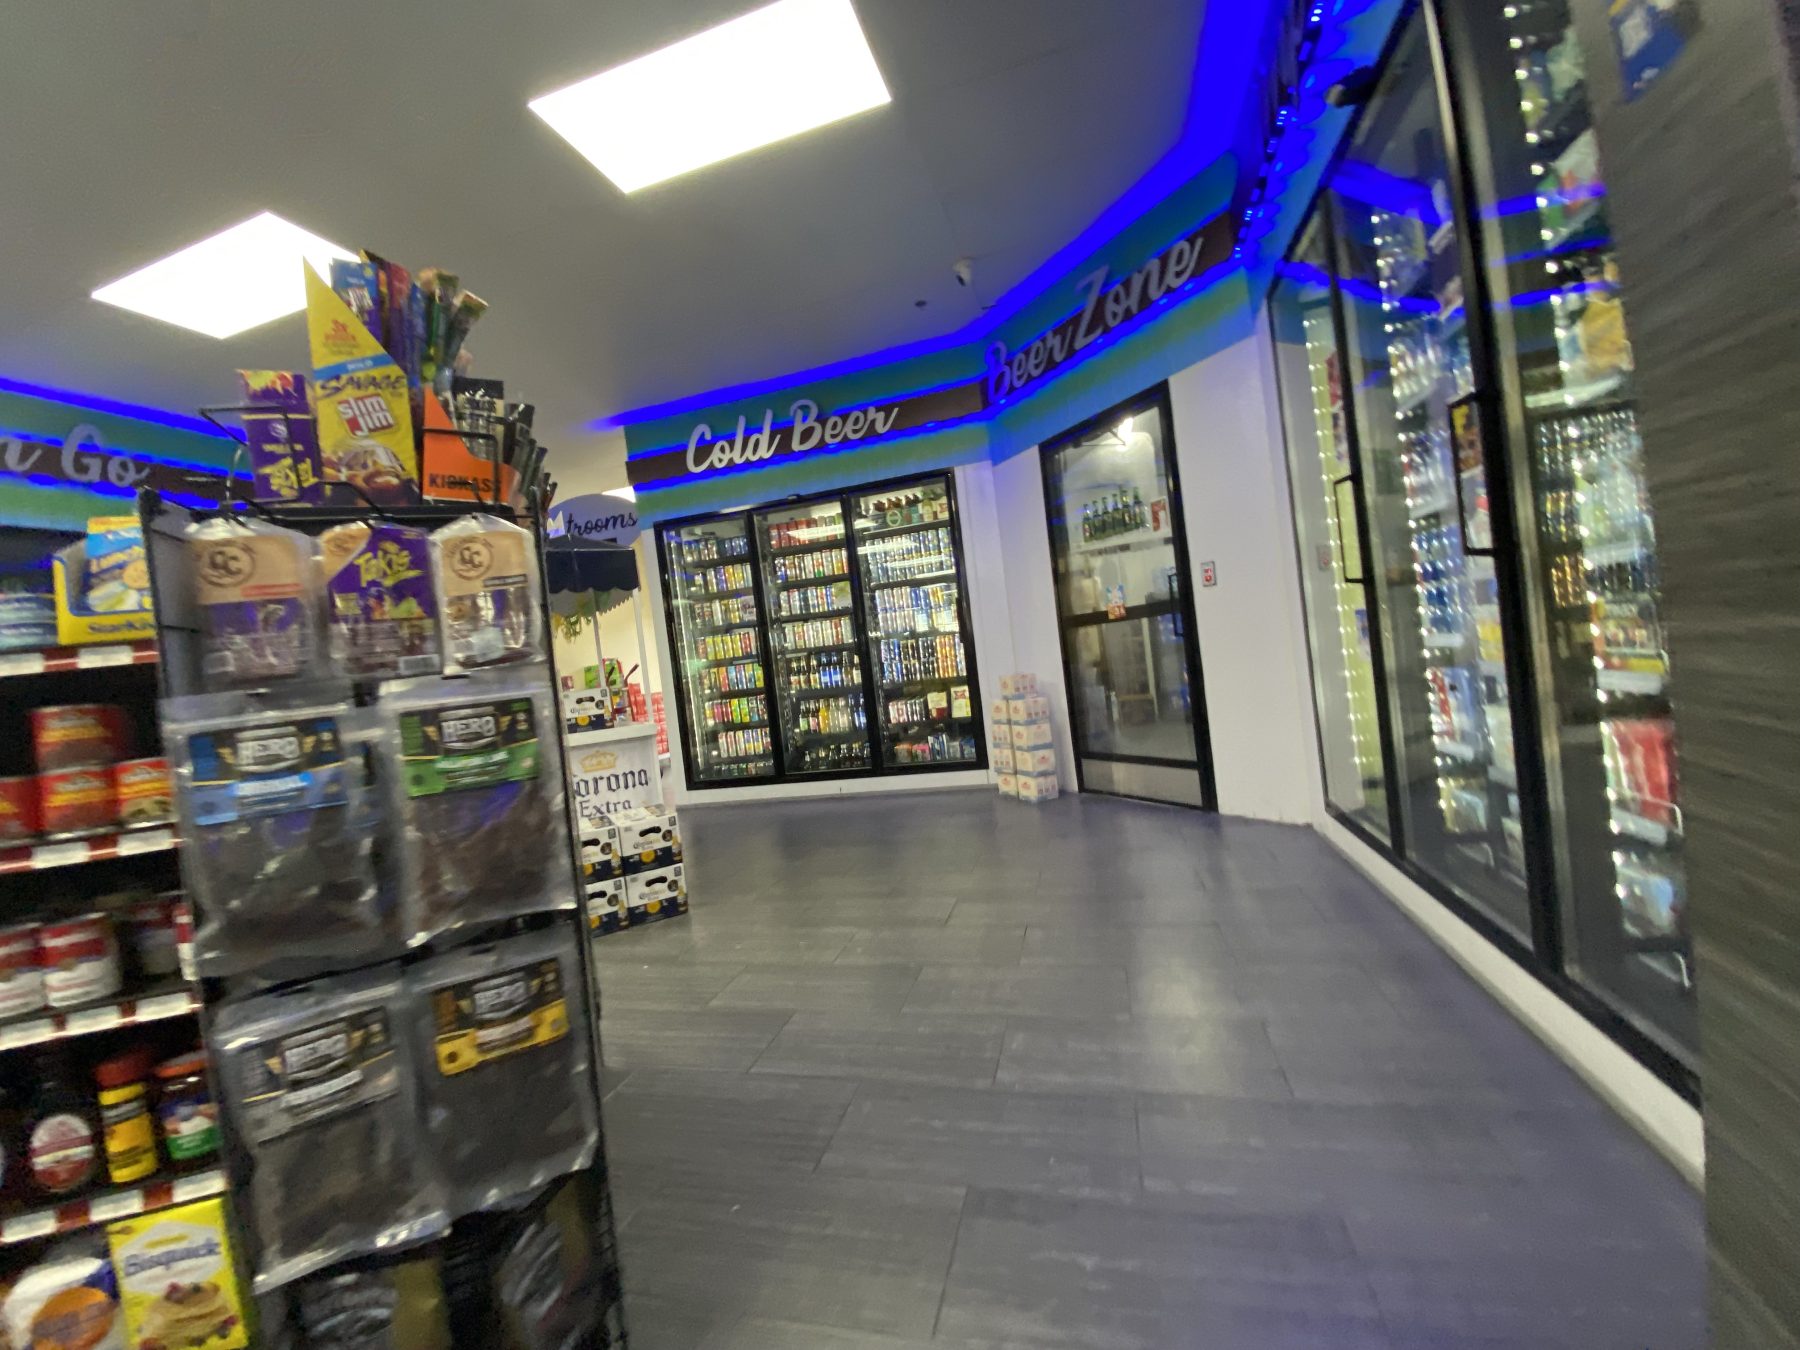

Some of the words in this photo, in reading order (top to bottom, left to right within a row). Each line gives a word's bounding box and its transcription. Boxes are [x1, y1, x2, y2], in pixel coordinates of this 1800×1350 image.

[985, 340, 1072, 402] Beer
[1073, 236, 1204, 350] Zone
[61, 423, 151, 489] Go
[686, 408, 782, 474] Cold
[789, 398, 899, 452] Beer
[572, 768, 649, 798] orona
[578, 799, 632, 817] Extra
